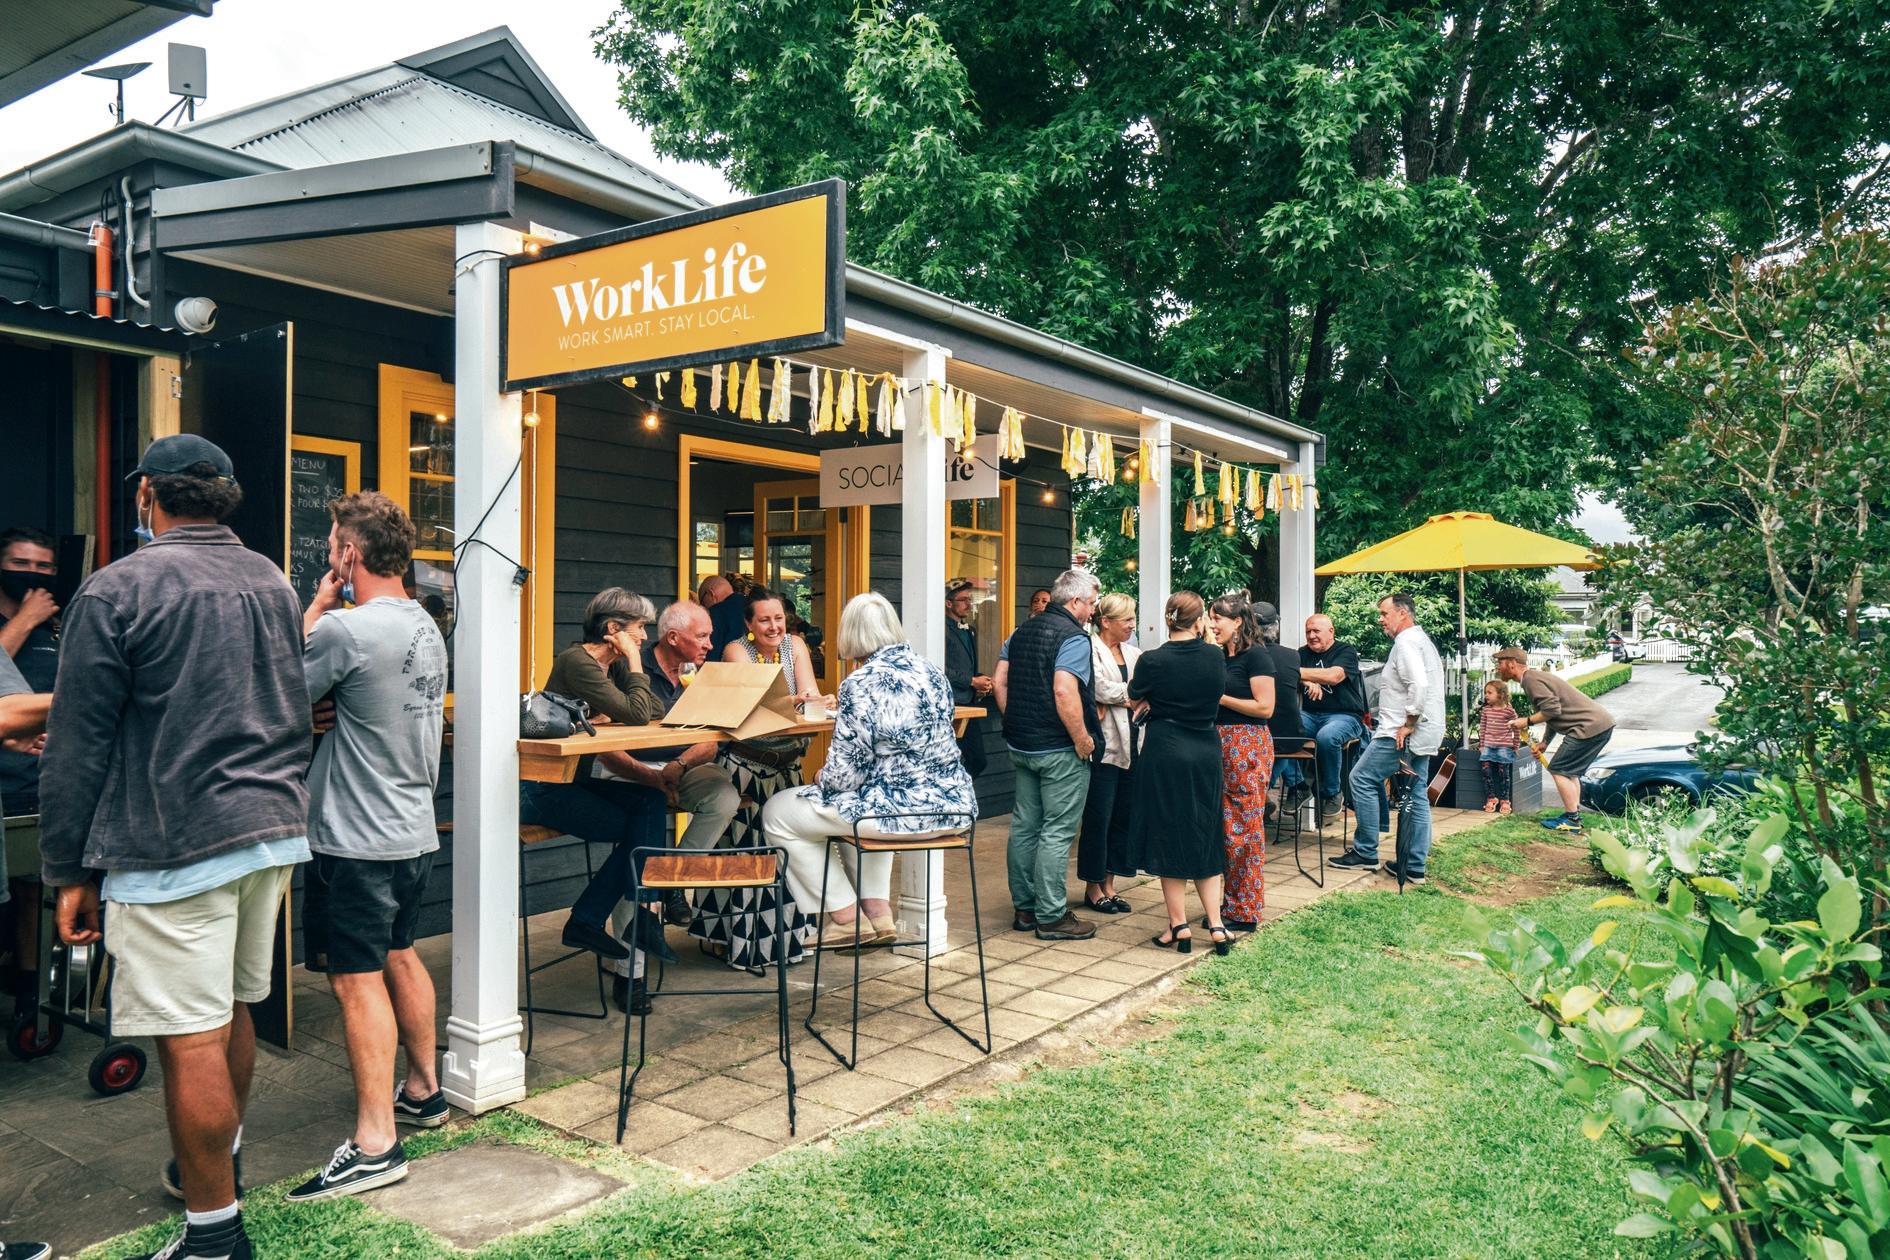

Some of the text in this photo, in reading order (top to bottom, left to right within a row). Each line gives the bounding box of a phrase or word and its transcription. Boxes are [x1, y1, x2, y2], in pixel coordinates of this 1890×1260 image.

[552, 242, 767, 328] WorkLife
[559, 303, 755, 350] WORK SMART. STAY LOCAL.
[839, 456, 975, 490] SOCIA ife
